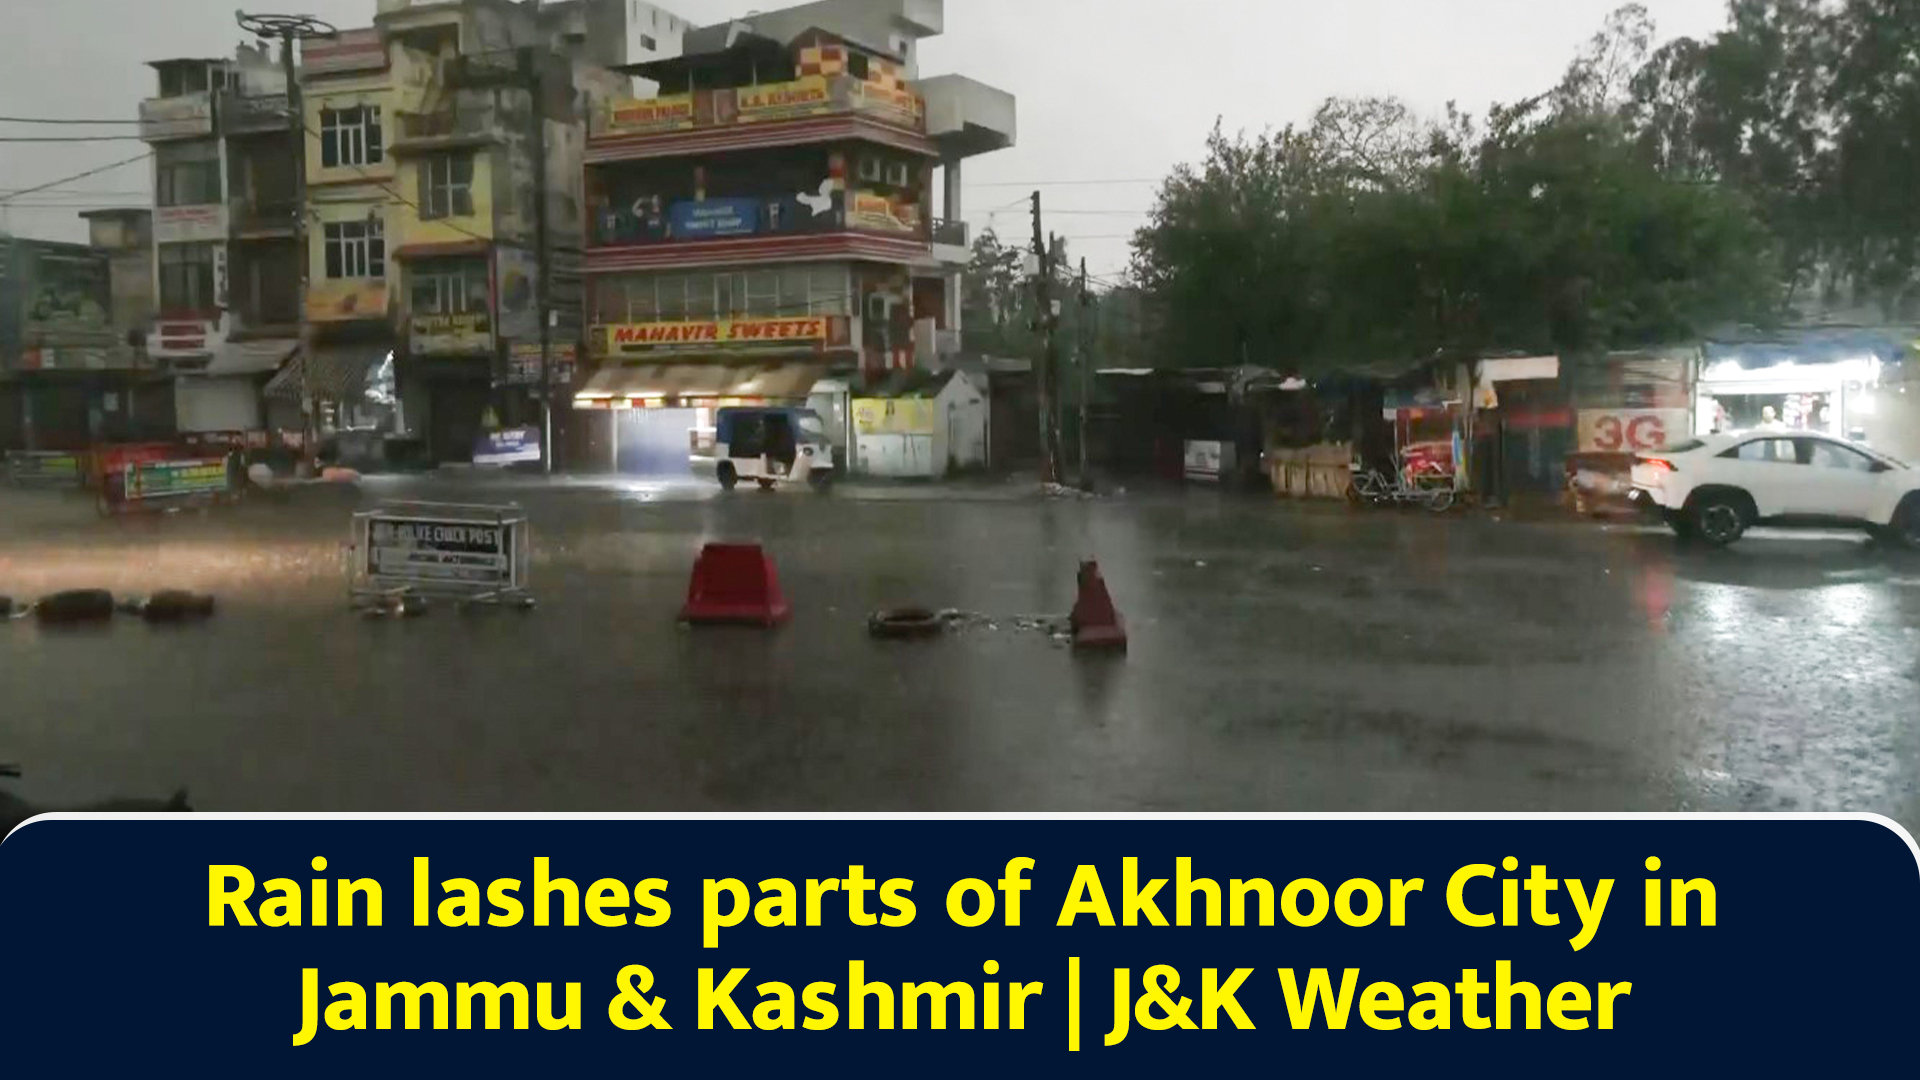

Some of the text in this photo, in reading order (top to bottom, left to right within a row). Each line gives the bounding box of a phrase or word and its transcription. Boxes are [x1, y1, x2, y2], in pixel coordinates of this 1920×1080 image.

[615, 320, 820, 342] MAHAVIR SWEETS
[1593, 414, 1666, 450] 3G
